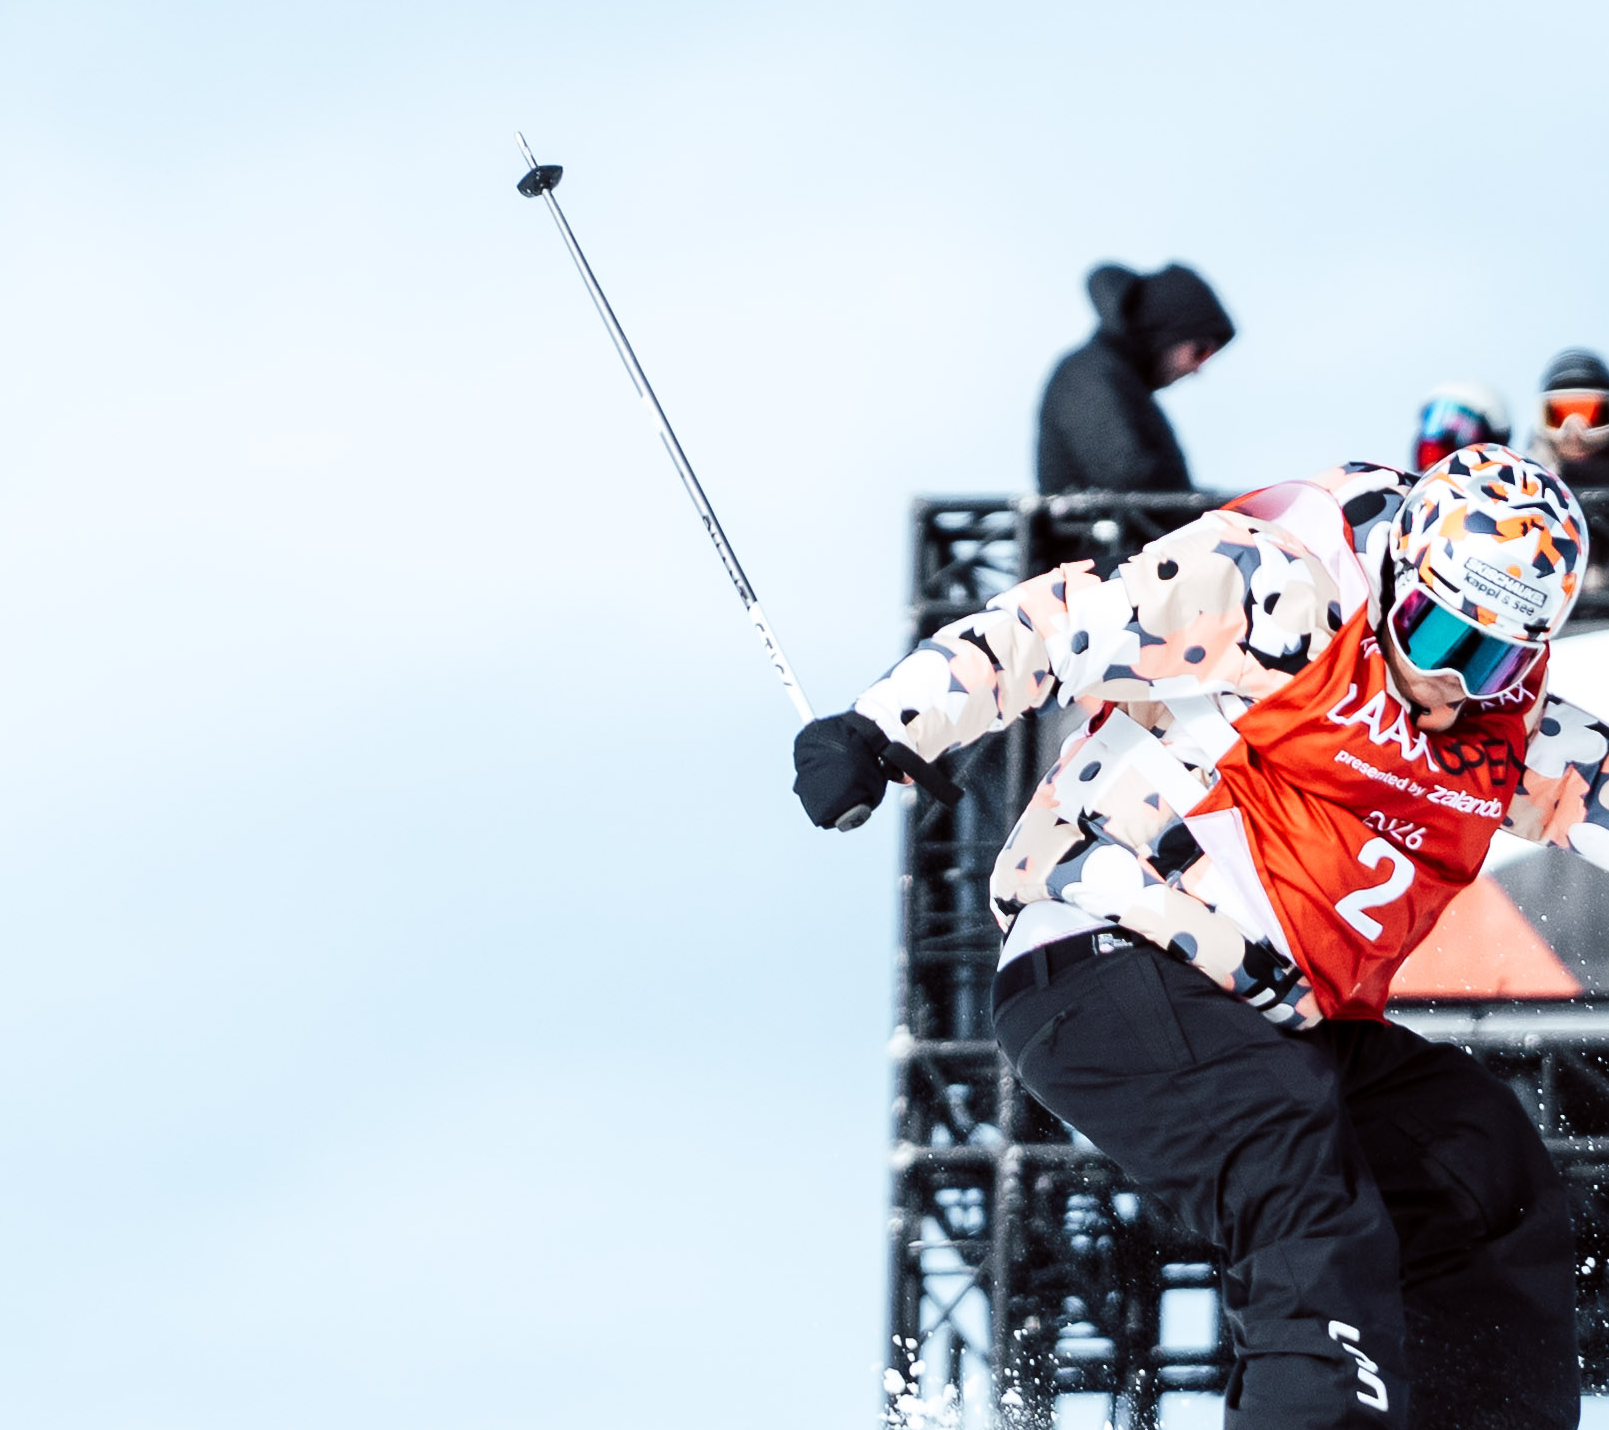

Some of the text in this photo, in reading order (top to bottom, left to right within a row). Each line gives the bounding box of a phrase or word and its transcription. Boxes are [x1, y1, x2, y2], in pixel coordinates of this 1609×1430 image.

[1334, 750, 1502, 818] presented by zalando
[1335, 837, 1416, 942] 2
